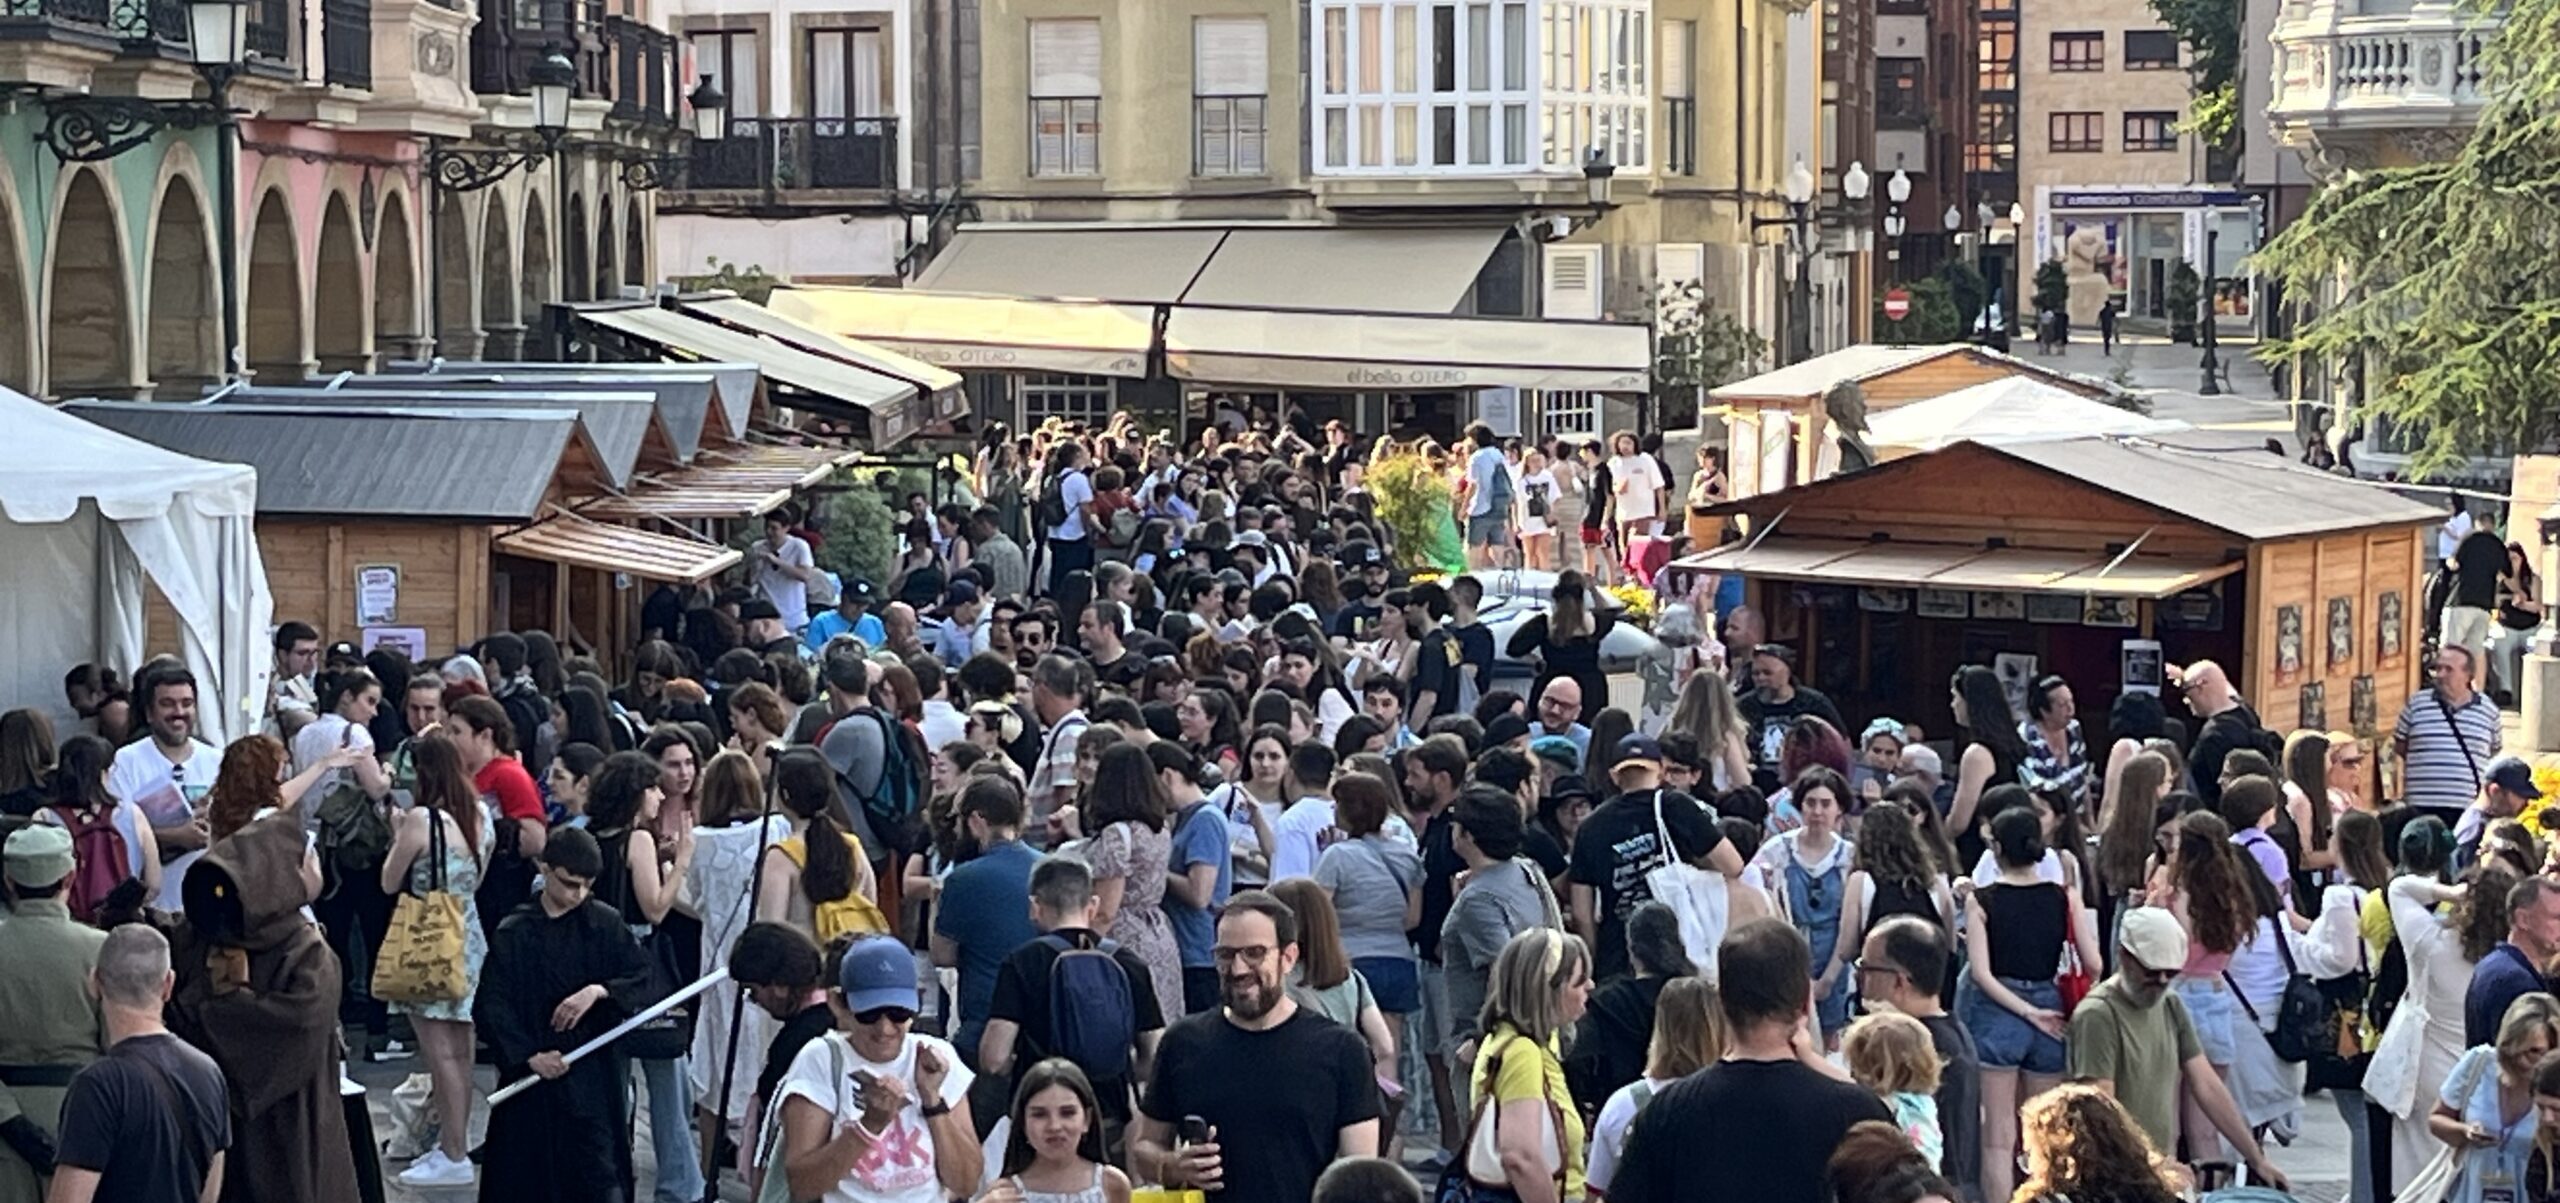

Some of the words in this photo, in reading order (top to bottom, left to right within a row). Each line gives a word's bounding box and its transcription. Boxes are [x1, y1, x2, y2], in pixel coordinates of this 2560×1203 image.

[959, 349, 1016, 363] OTERO
[1364, 368, 1402, 384] bello
[1410, 370, 1467, 384] OTERO
